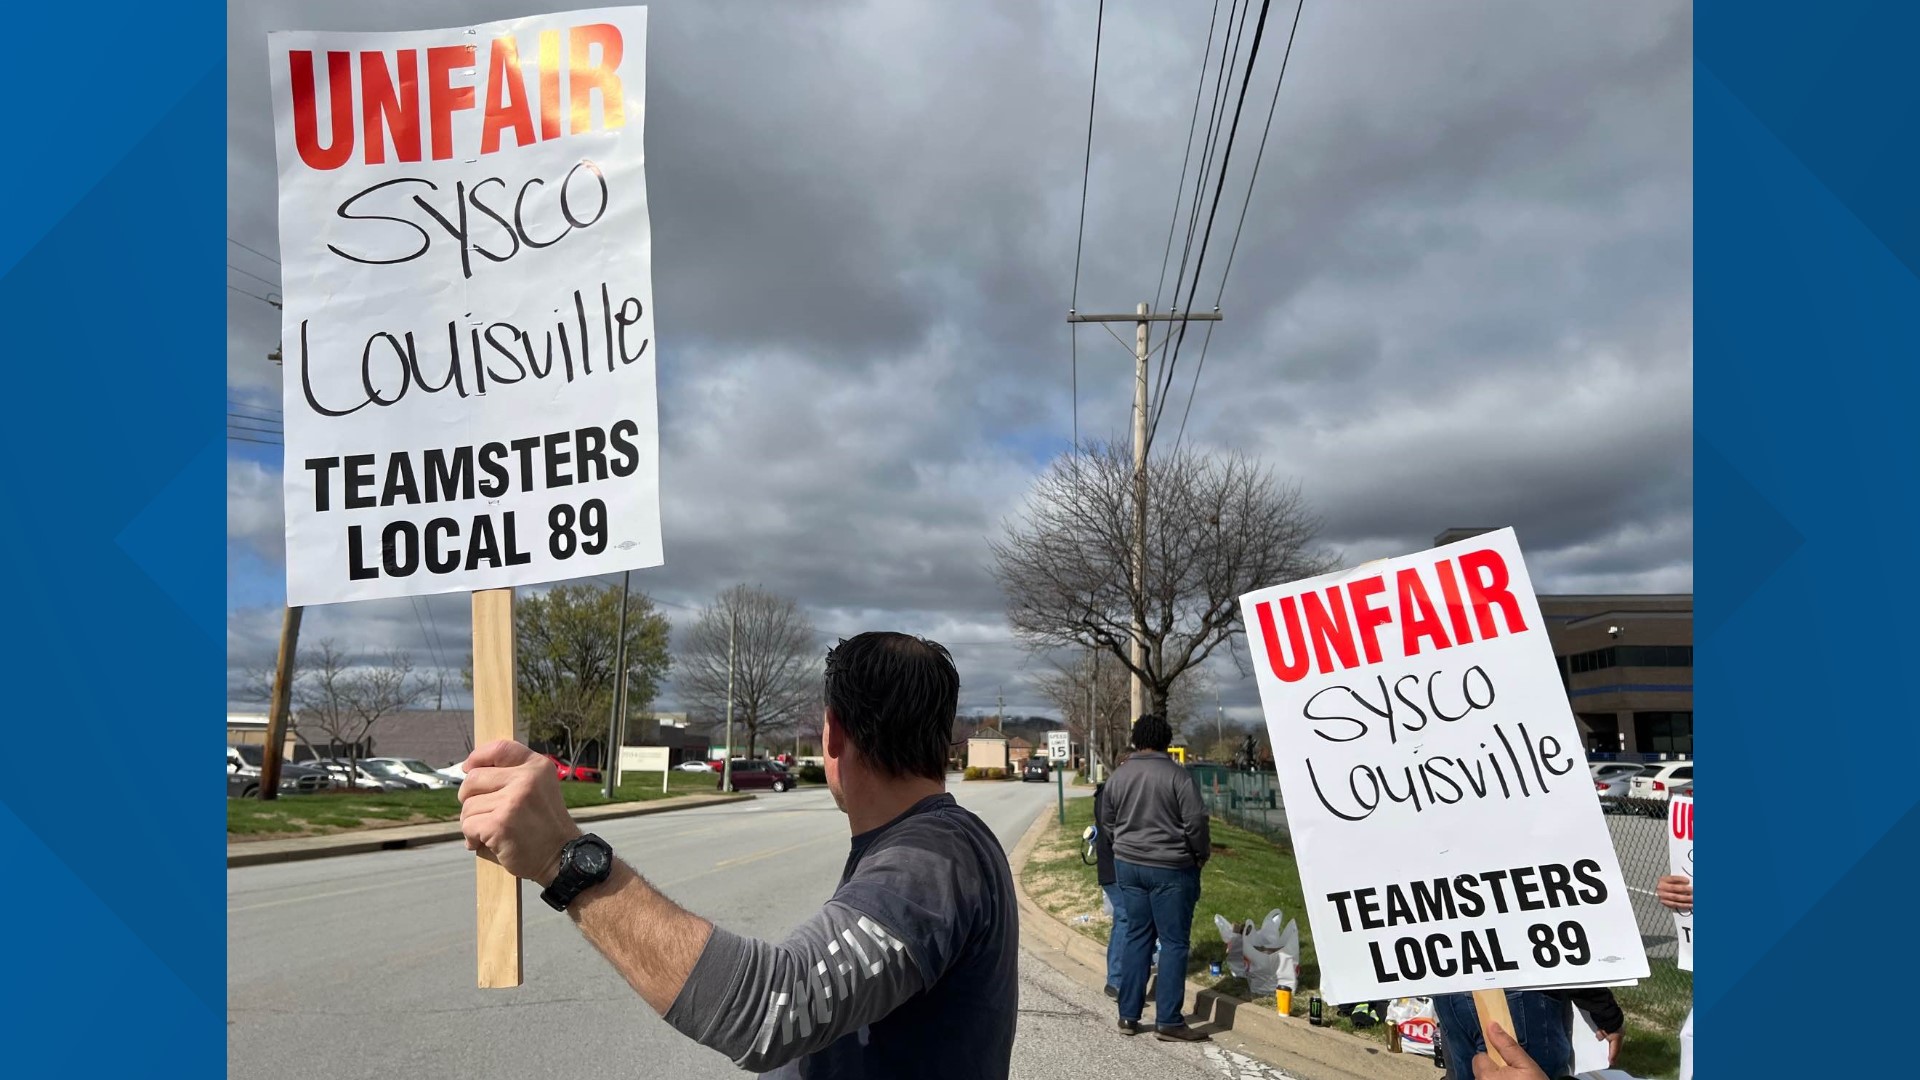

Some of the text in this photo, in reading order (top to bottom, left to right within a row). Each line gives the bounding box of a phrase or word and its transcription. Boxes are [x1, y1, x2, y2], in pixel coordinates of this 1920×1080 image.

[288, 23, 627, 171] UNFAIR
[302, 283, 649, 416] Louisville
[305, 420, 639, 512] TEAMSTERS
[348, 499, 608, 581] LOCAL 89
[1255, 549, 1529, 684] UNFAIR
[1051, 746, 1066, 757] 15
[1305, 722, 1574, 822] Louisville
[1326, 859, 1608, 933] TEAMSTERS
[1369, 921, 1591, 984] LOCAL 89
[1403, 1023, 1435, 1038] DQ
